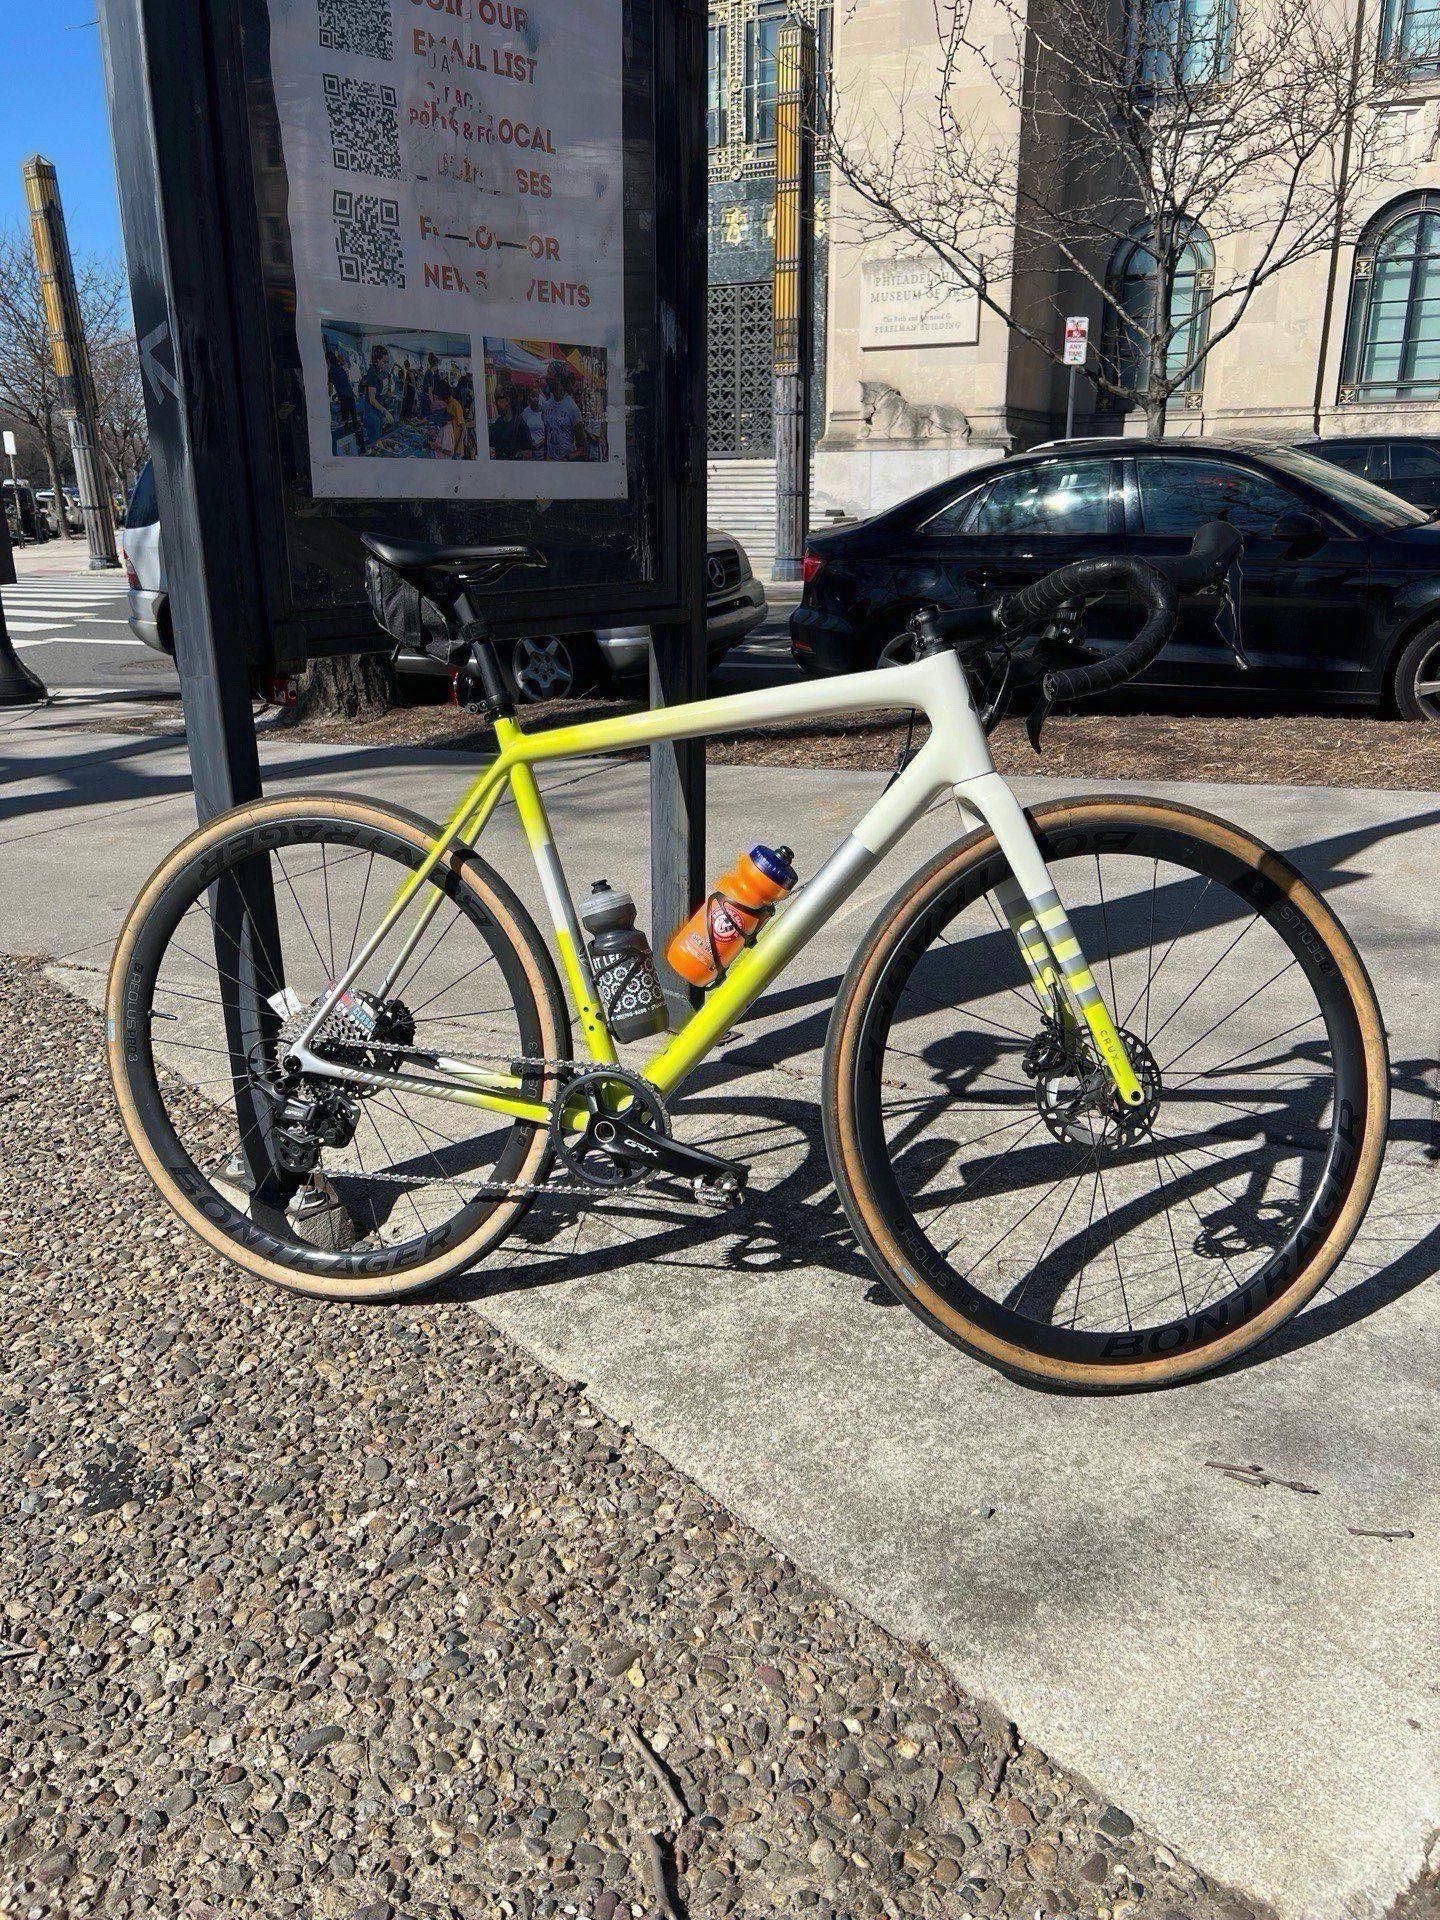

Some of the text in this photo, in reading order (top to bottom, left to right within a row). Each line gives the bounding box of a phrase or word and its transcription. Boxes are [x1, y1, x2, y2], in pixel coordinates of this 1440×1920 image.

[478, 0, 528, 31] OUR
[492, 49, 538, 84] LIST
[498, 118, 556, 154] OCAL
[528, 234, 560, 262] OR
[526, 278, 591, 308] ENTS
[1100, 1030, 1120, 1062] CRUX
[624, 1139, 659, 1157] GRX
